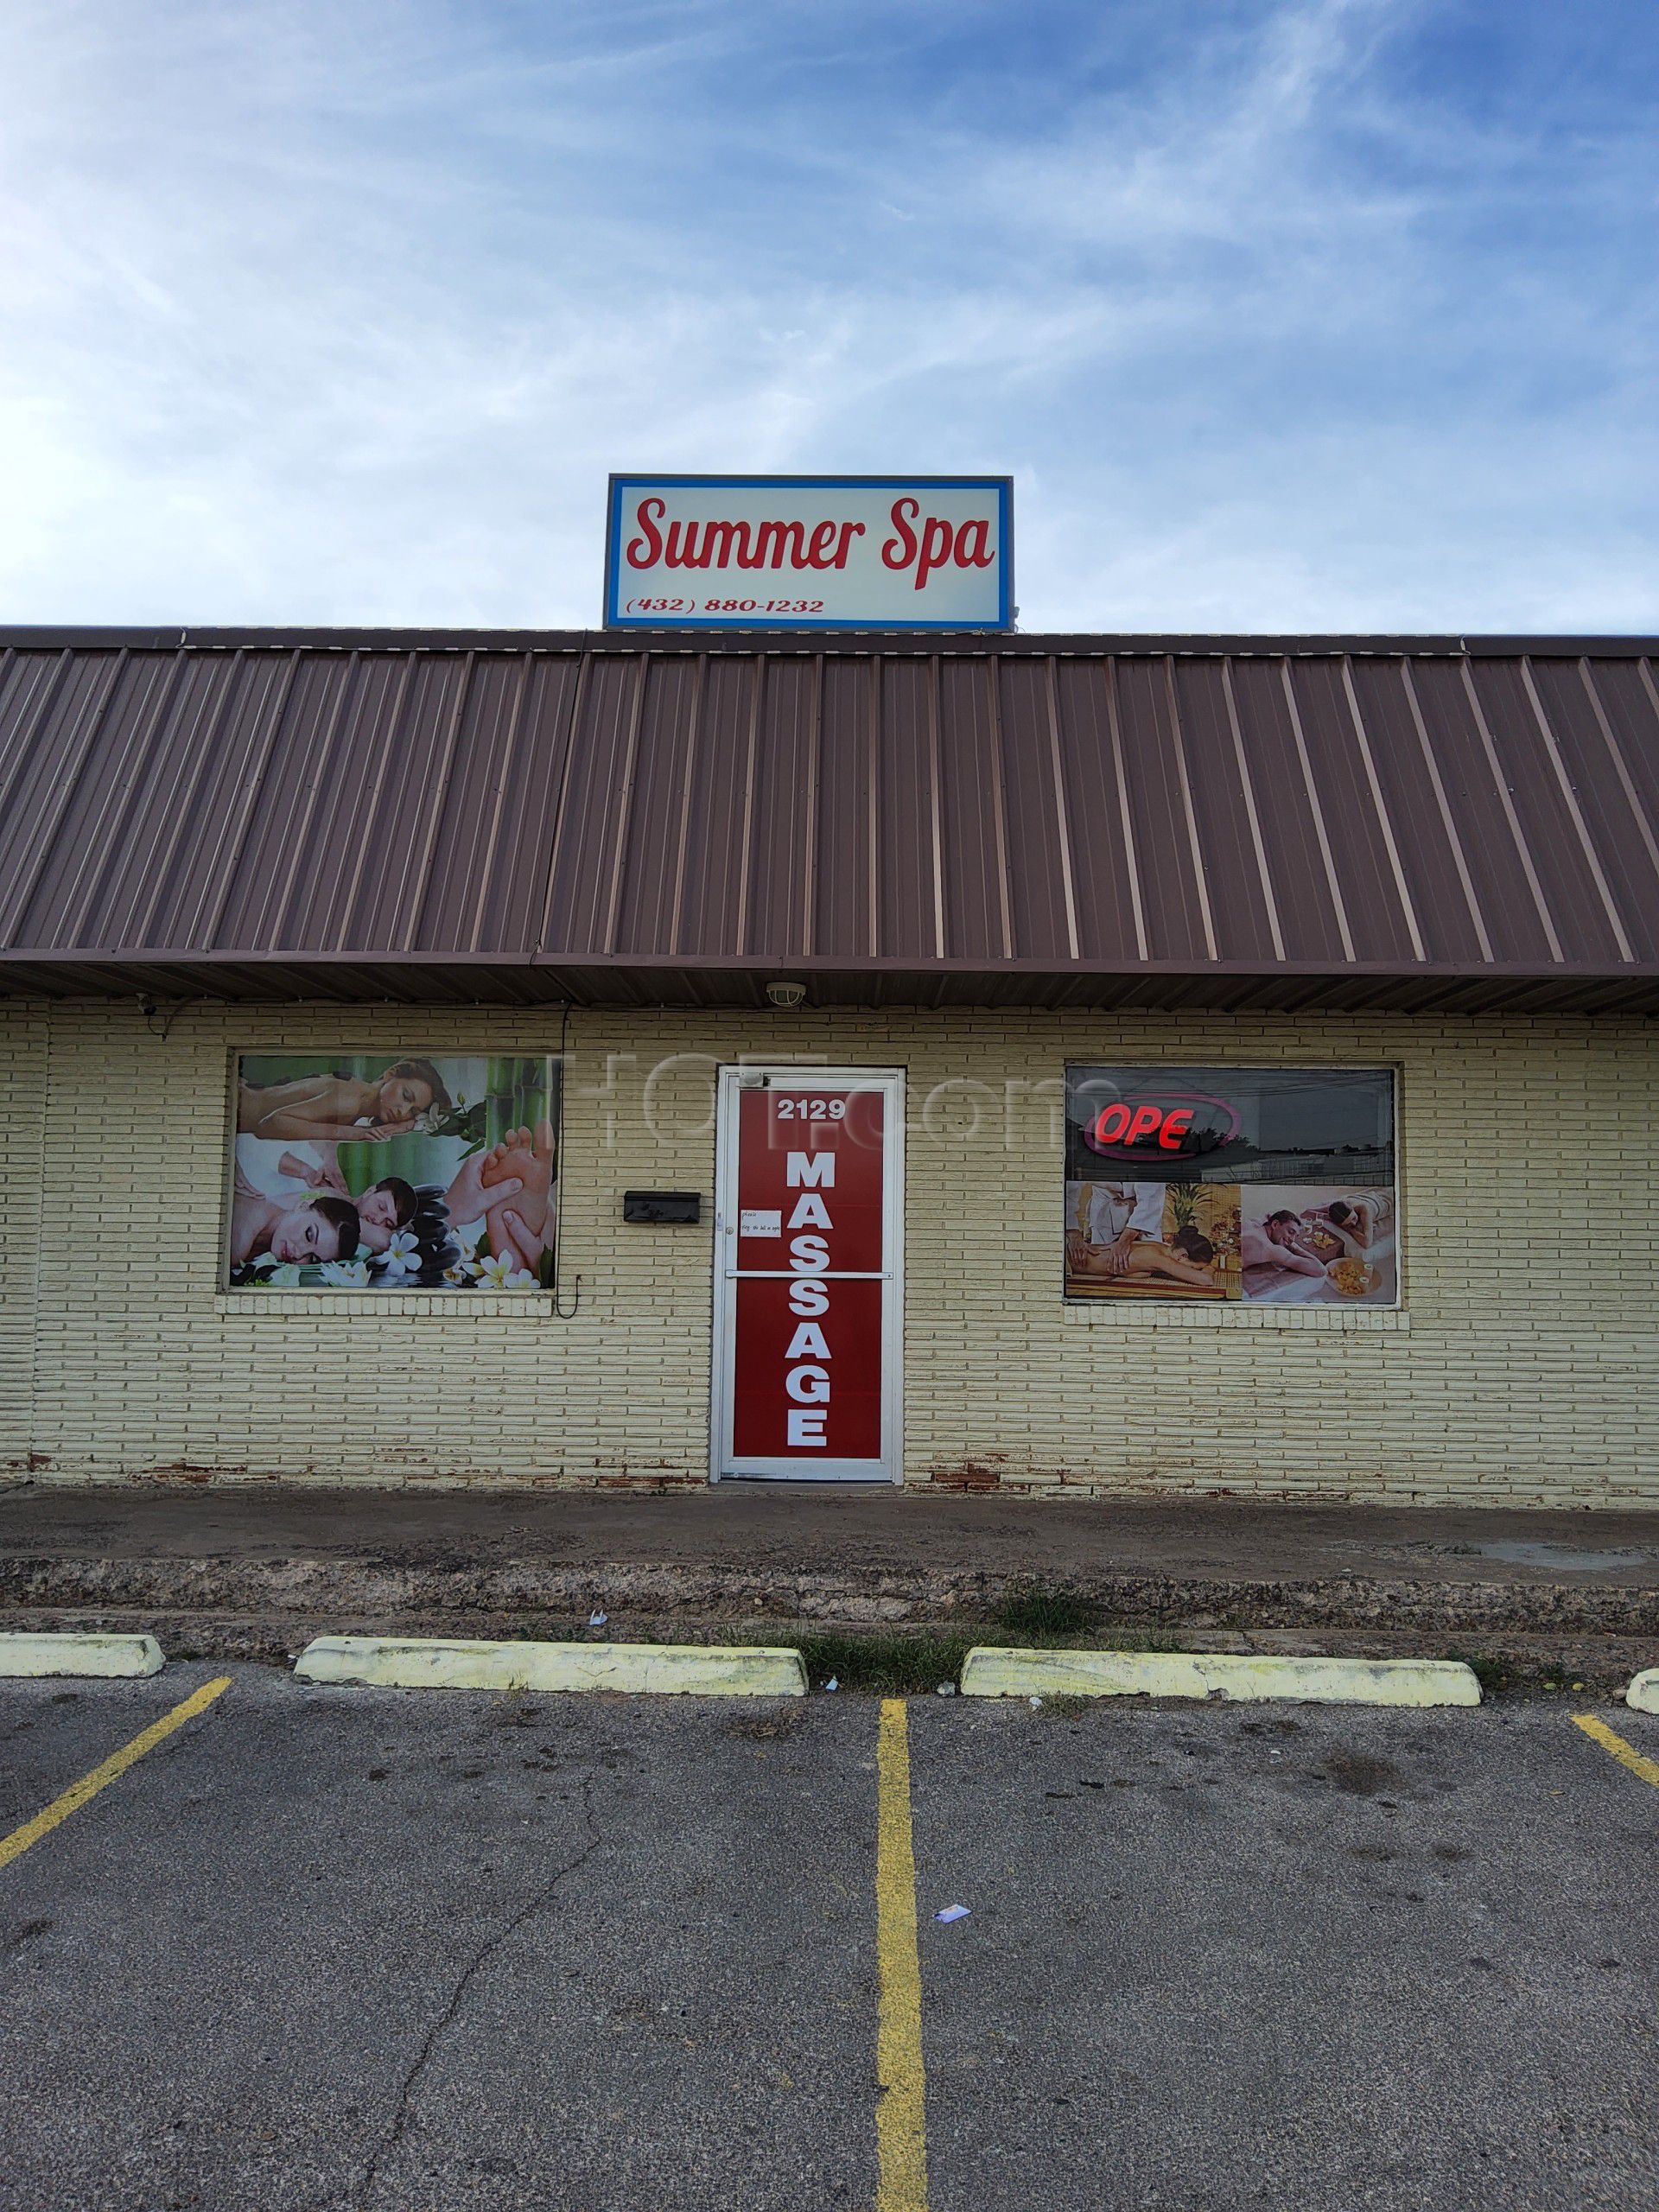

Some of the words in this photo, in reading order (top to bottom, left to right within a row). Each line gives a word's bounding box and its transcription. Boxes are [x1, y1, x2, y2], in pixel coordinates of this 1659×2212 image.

[626, 498, 865, 569] Summer
[881, 498, 995, 590] Spa
[626, 599, 696, 614] (432)
[704, 600, 824, 613] 880-1232
[778, 1099, 847, 1120] 2129
[785, 1152, 836, 1446] MASSAGE
